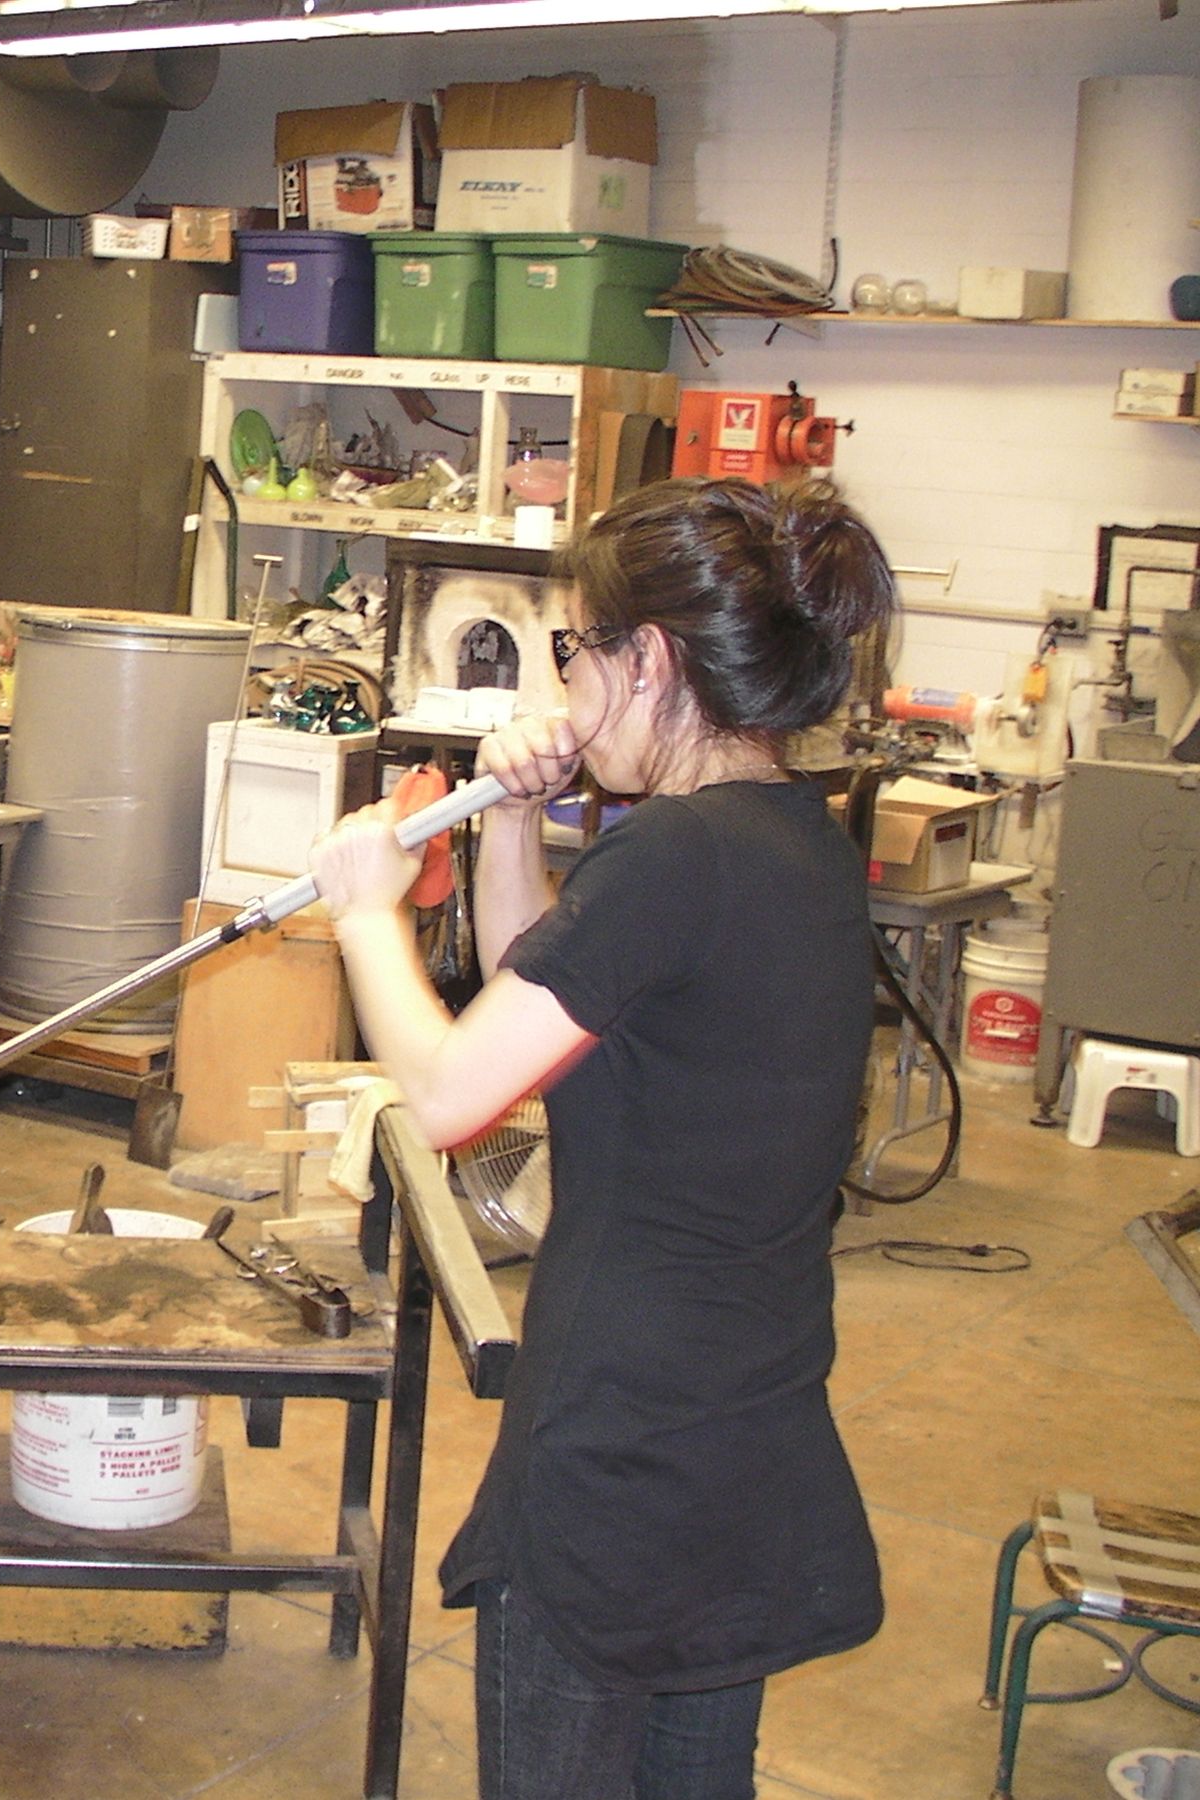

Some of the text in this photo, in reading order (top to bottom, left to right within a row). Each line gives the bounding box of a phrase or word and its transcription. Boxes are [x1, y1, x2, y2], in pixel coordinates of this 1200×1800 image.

[459, 181, 524, 193] ELKAY
[325, 368, 365, 379] DANGER
[476, 373, 490, 384] UP
[504, 375, 531, 388] HERE
[100, 1449, 151, 1459] STACKING
[111, 1462, 136, 1470] HIGH
[150, 1454, 181, 1467] PALLET
[99, 1463, 181, 1479] 2 PALLETS HIGH
